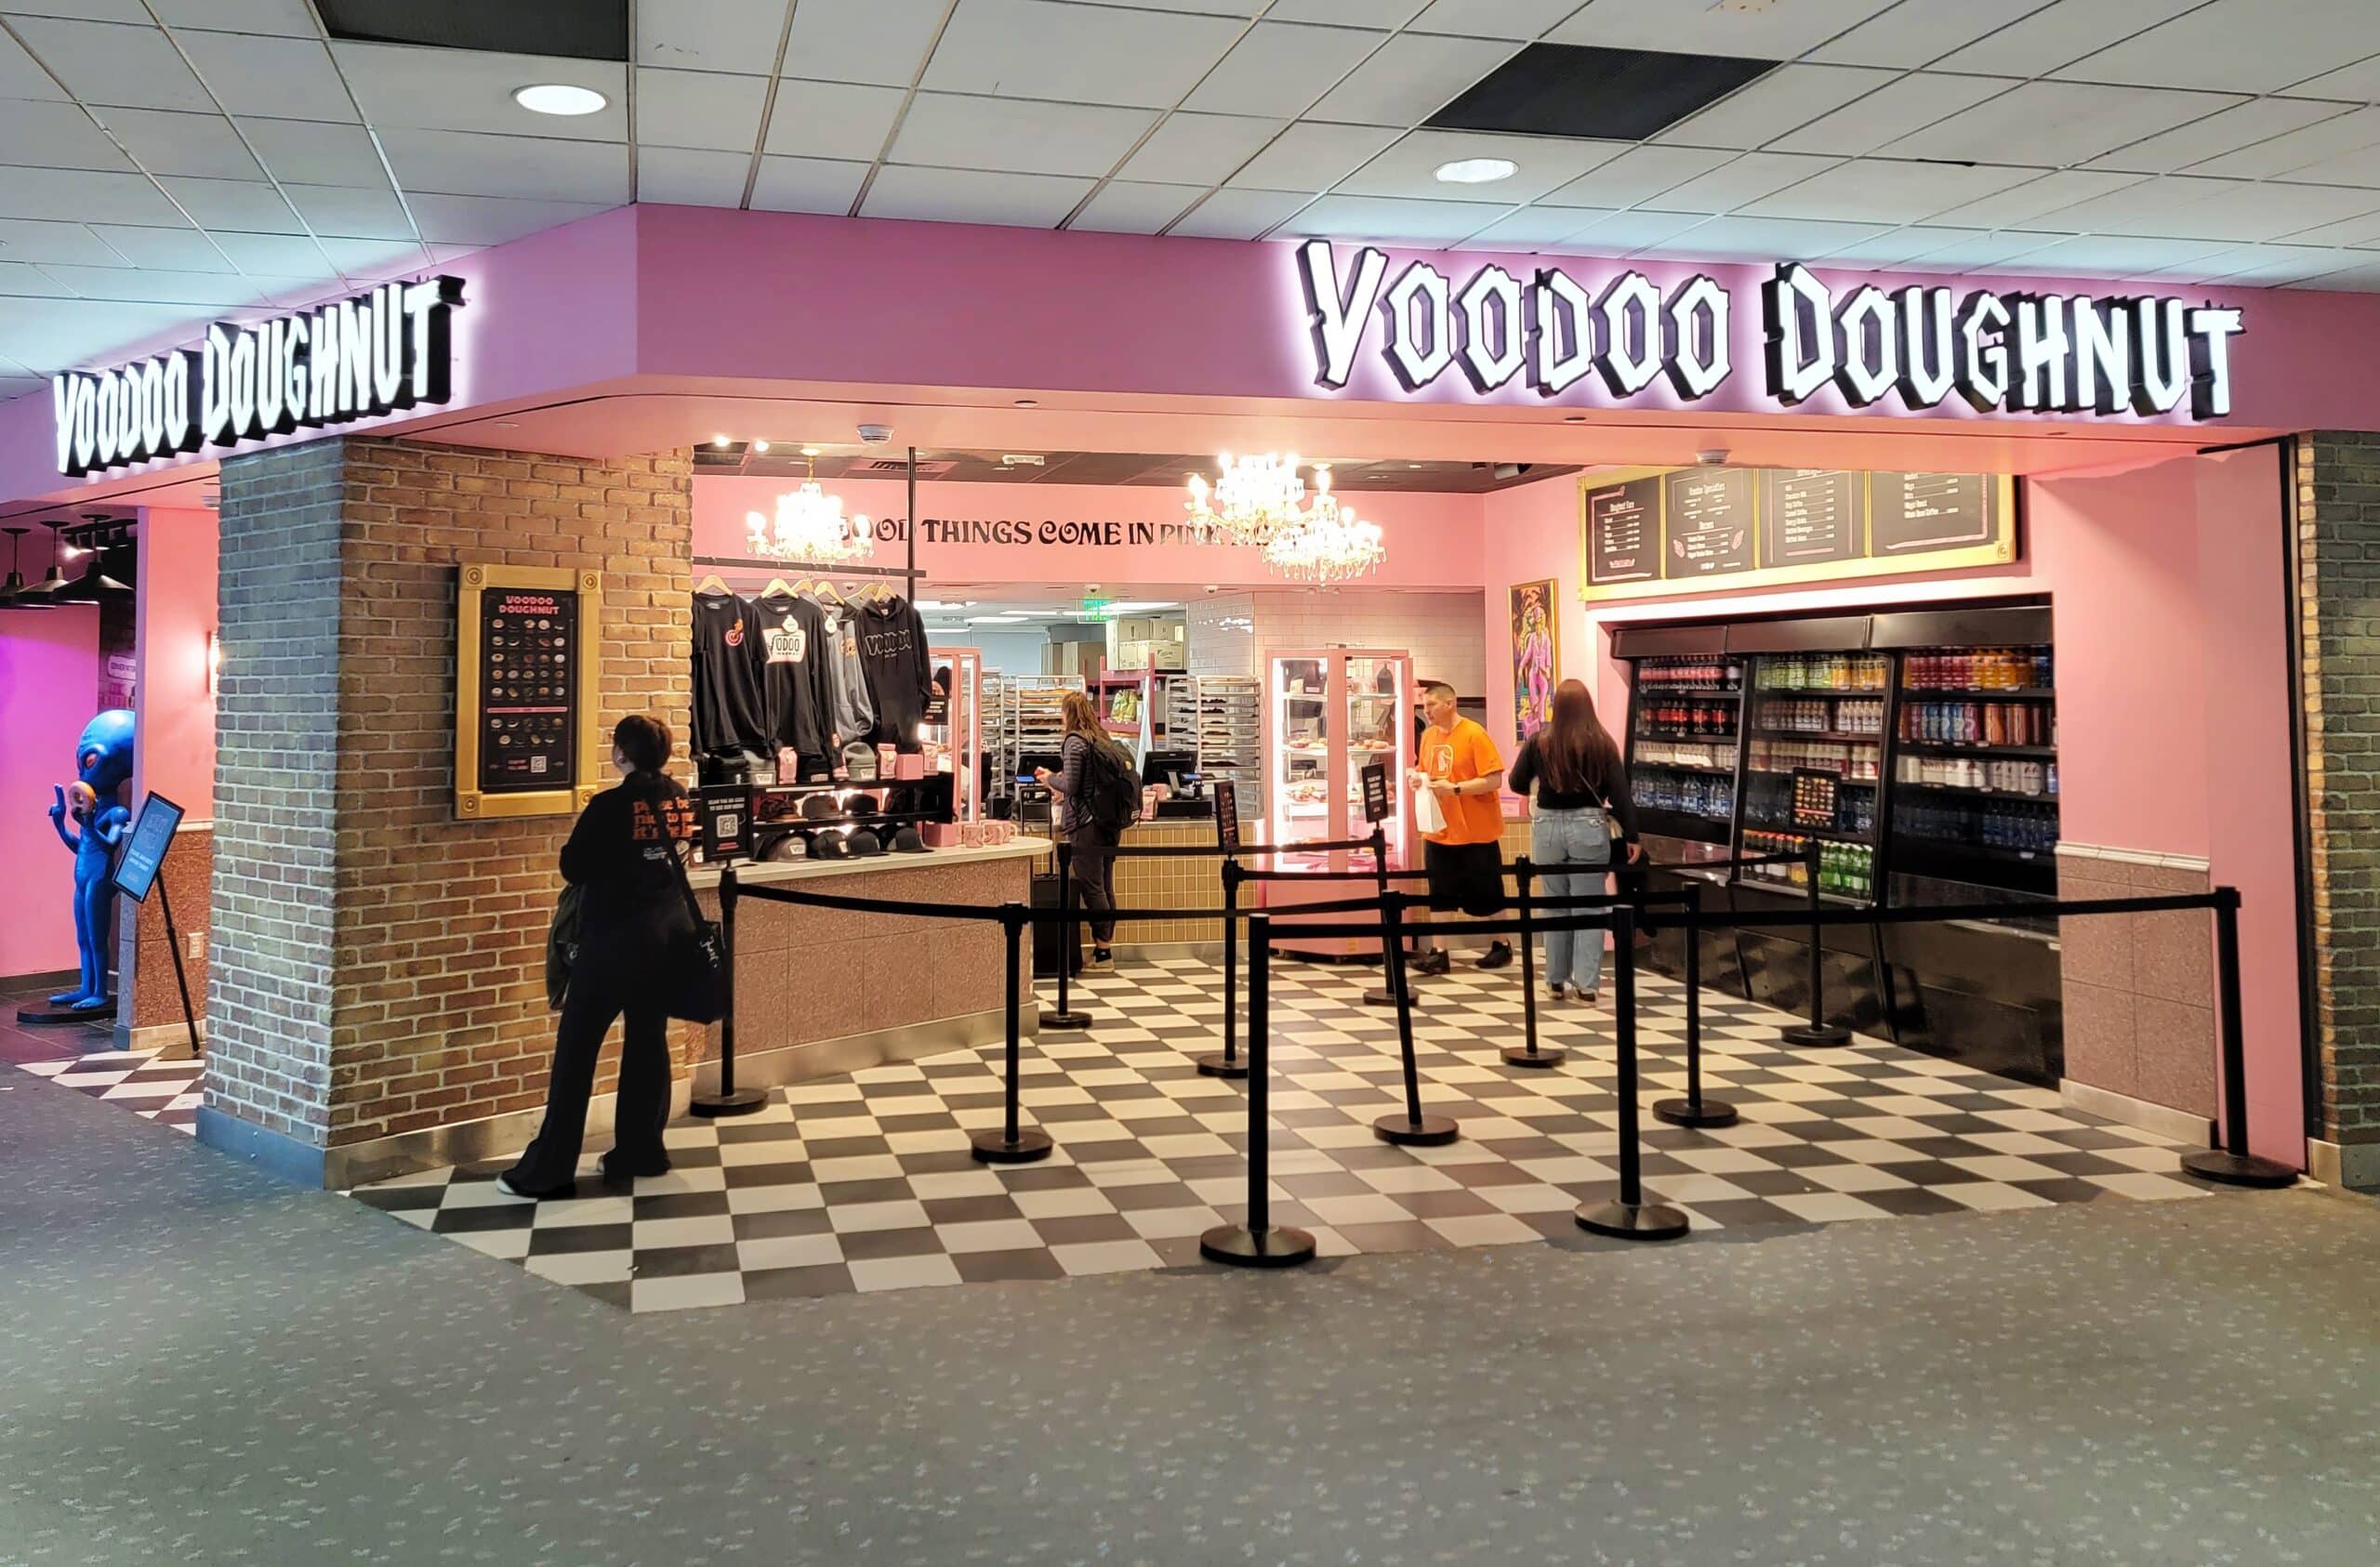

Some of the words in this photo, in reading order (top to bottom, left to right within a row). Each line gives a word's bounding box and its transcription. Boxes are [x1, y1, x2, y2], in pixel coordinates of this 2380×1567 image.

[1295, 239, 1733, 402] VOODOO
[1762, 261, 2246, 421] DOUGHNUT
[53, 347, 198, 477] VOODOO
[203, 276, 465, 447] DOUGHNUT
[839, 517, 916, 542] OOD
[921, 519, 1033, 546] THINGS
[1038, 520, 1122, 546] COME
[1129, 521, 1155, 546] IN
[498, 604, 560, 615] DOUGHNUT
[505, 595, 554, 605] VOODOO
